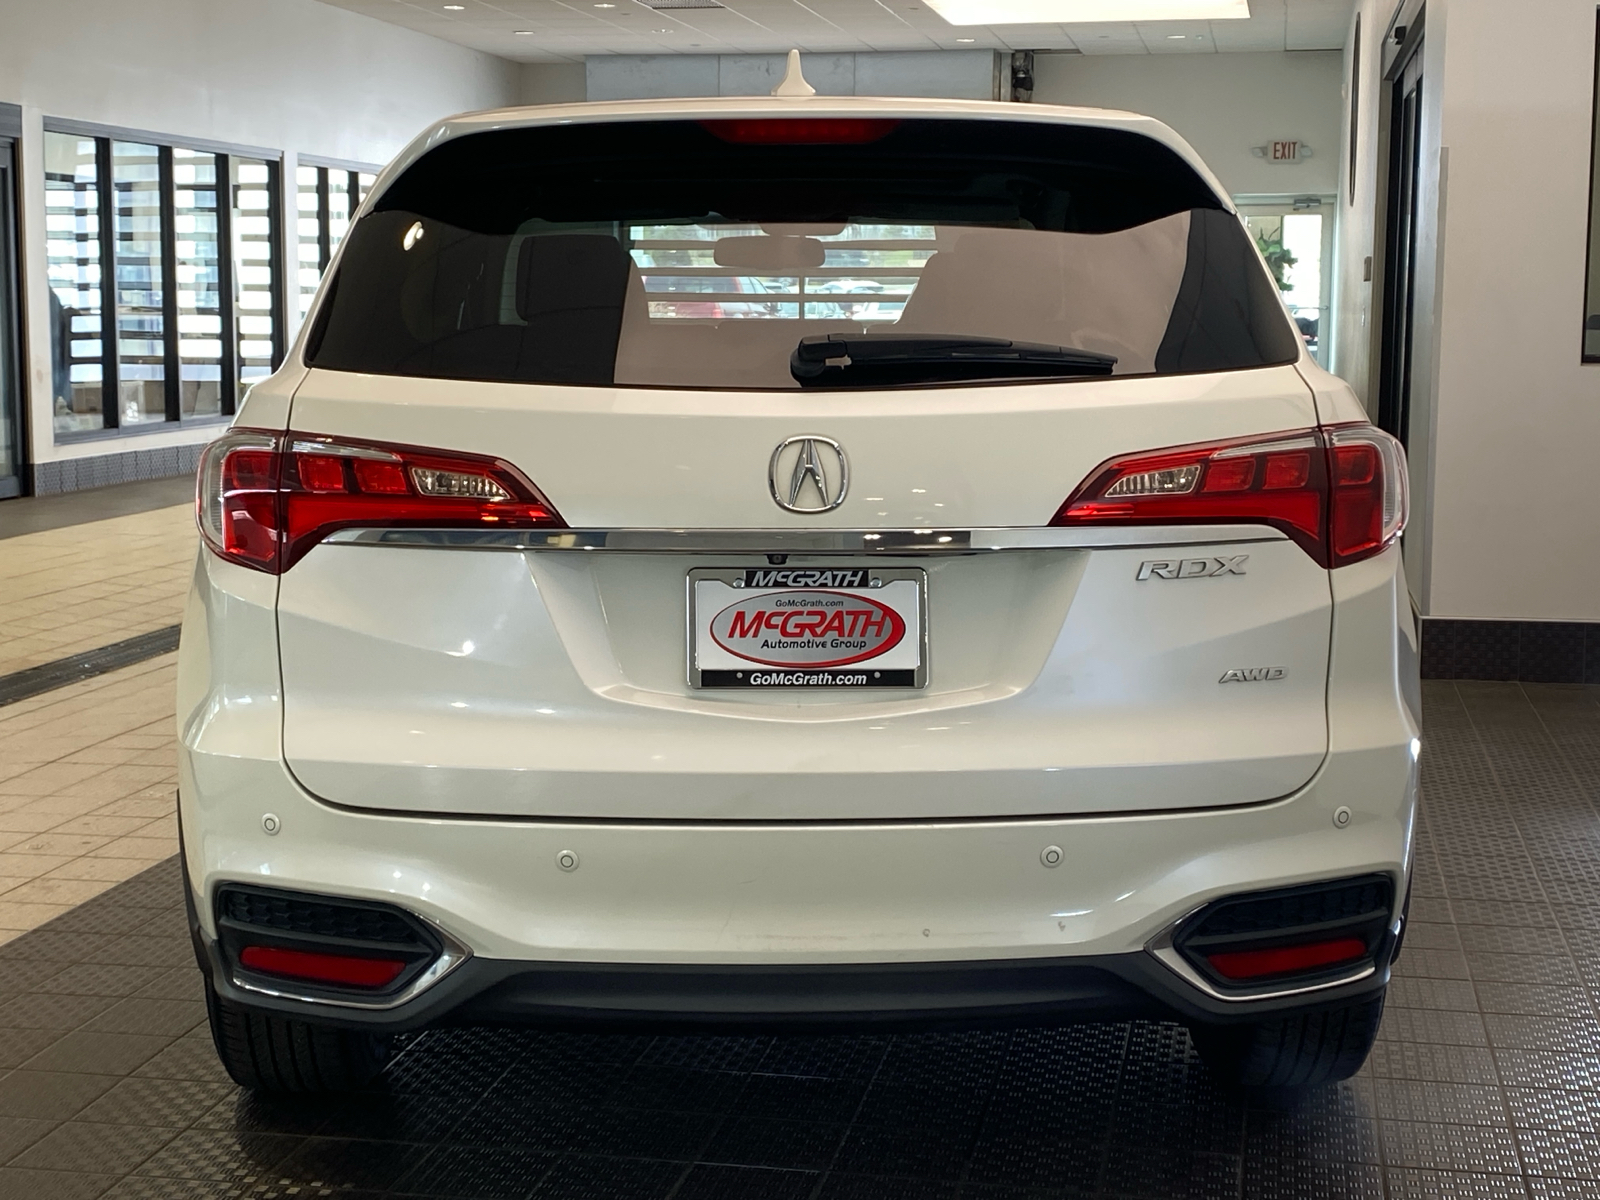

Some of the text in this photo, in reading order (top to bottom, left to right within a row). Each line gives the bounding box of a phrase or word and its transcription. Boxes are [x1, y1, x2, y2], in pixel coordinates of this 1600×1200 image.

[1273, 141, 1298, 160] EXIT
[1135, 554, 1250, 581] RDX
[751, 570, 864, 587] McGRATH
[775, 599, 844, 608] GoMcGrath.com
[727, 610, 888, 639] McGRATH
[760, 638, 867, 651] Automotive Group
[750, 672, 867, 686] GoMcGrath.com
[1218, 666, 1289, 684] AWD
